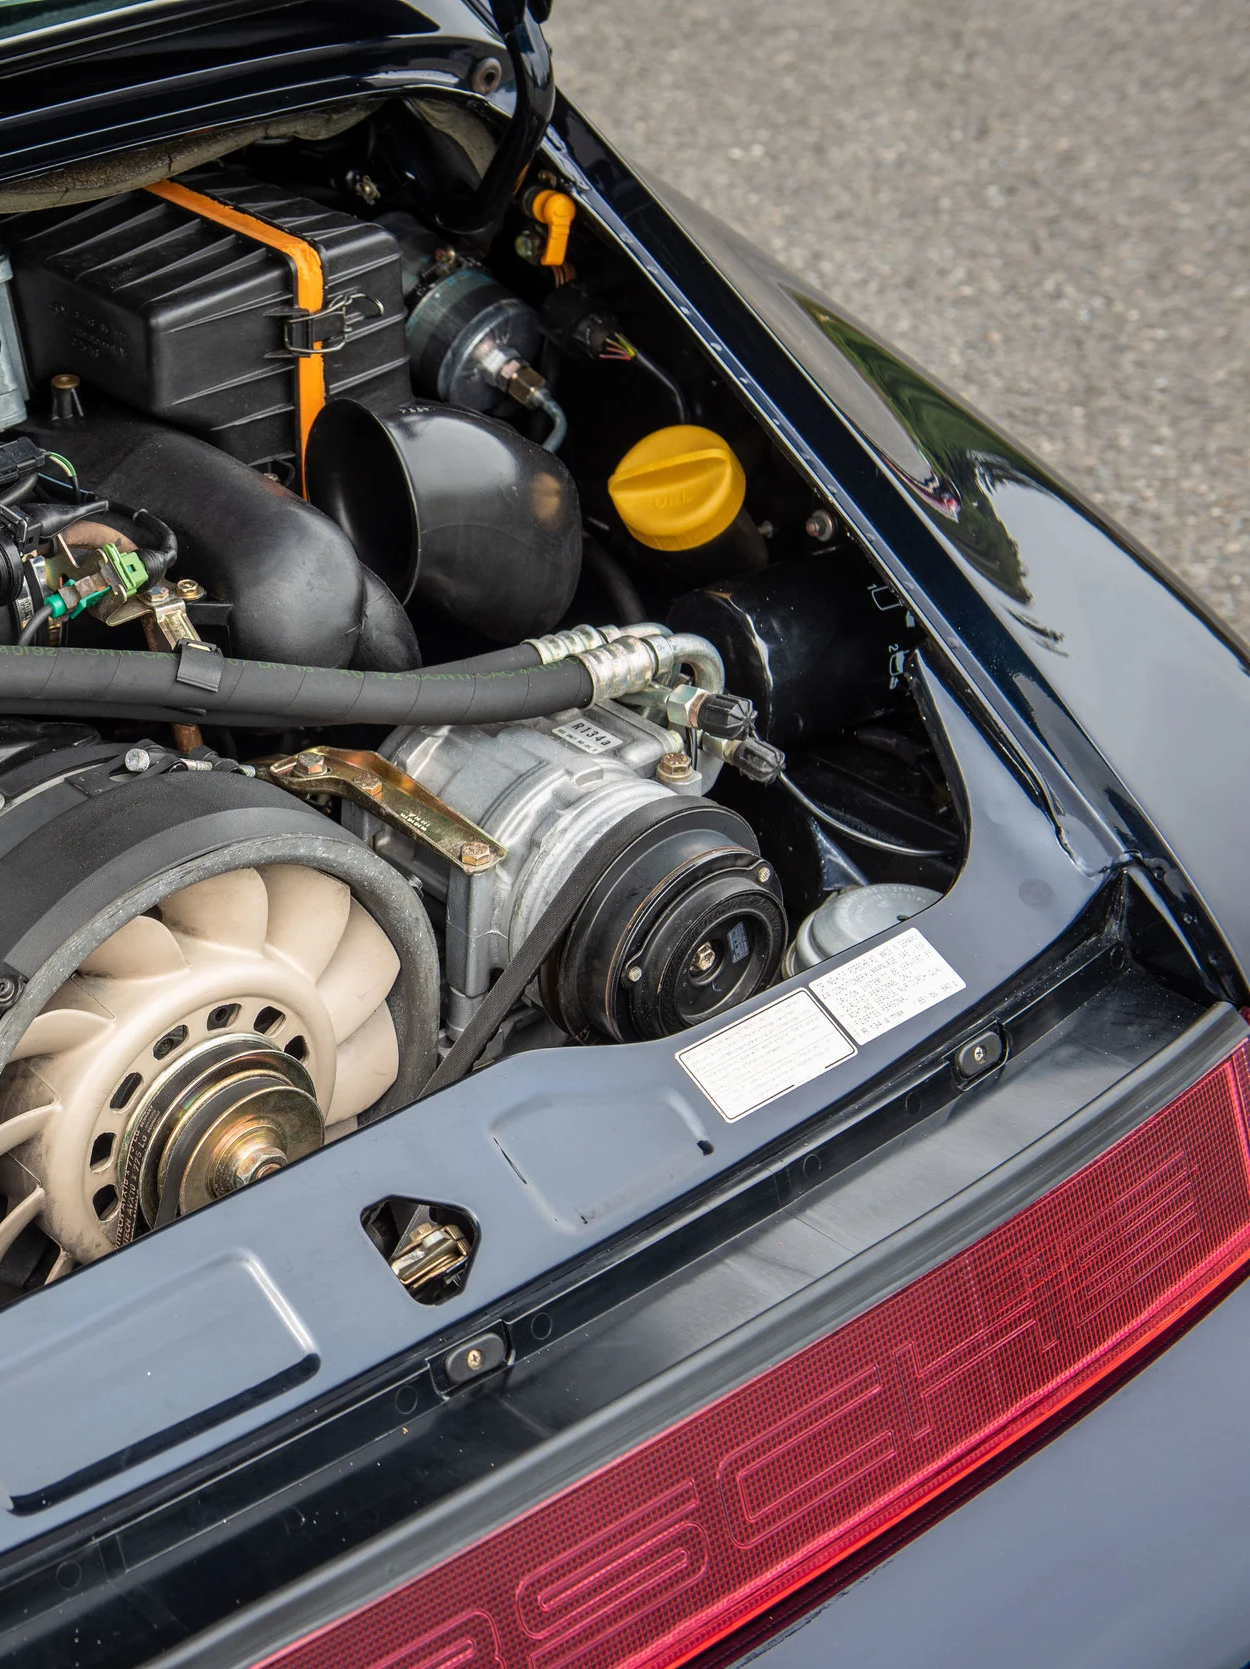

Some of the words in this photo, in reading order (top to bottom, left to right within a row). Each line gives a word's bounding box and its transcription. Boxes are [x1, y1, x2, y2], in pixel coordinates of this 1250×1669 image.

[571, 722, 612, 746] R134a
[127, 1183, 137, 1217] AVX10
[133, 1151, 143, 1172] 775
